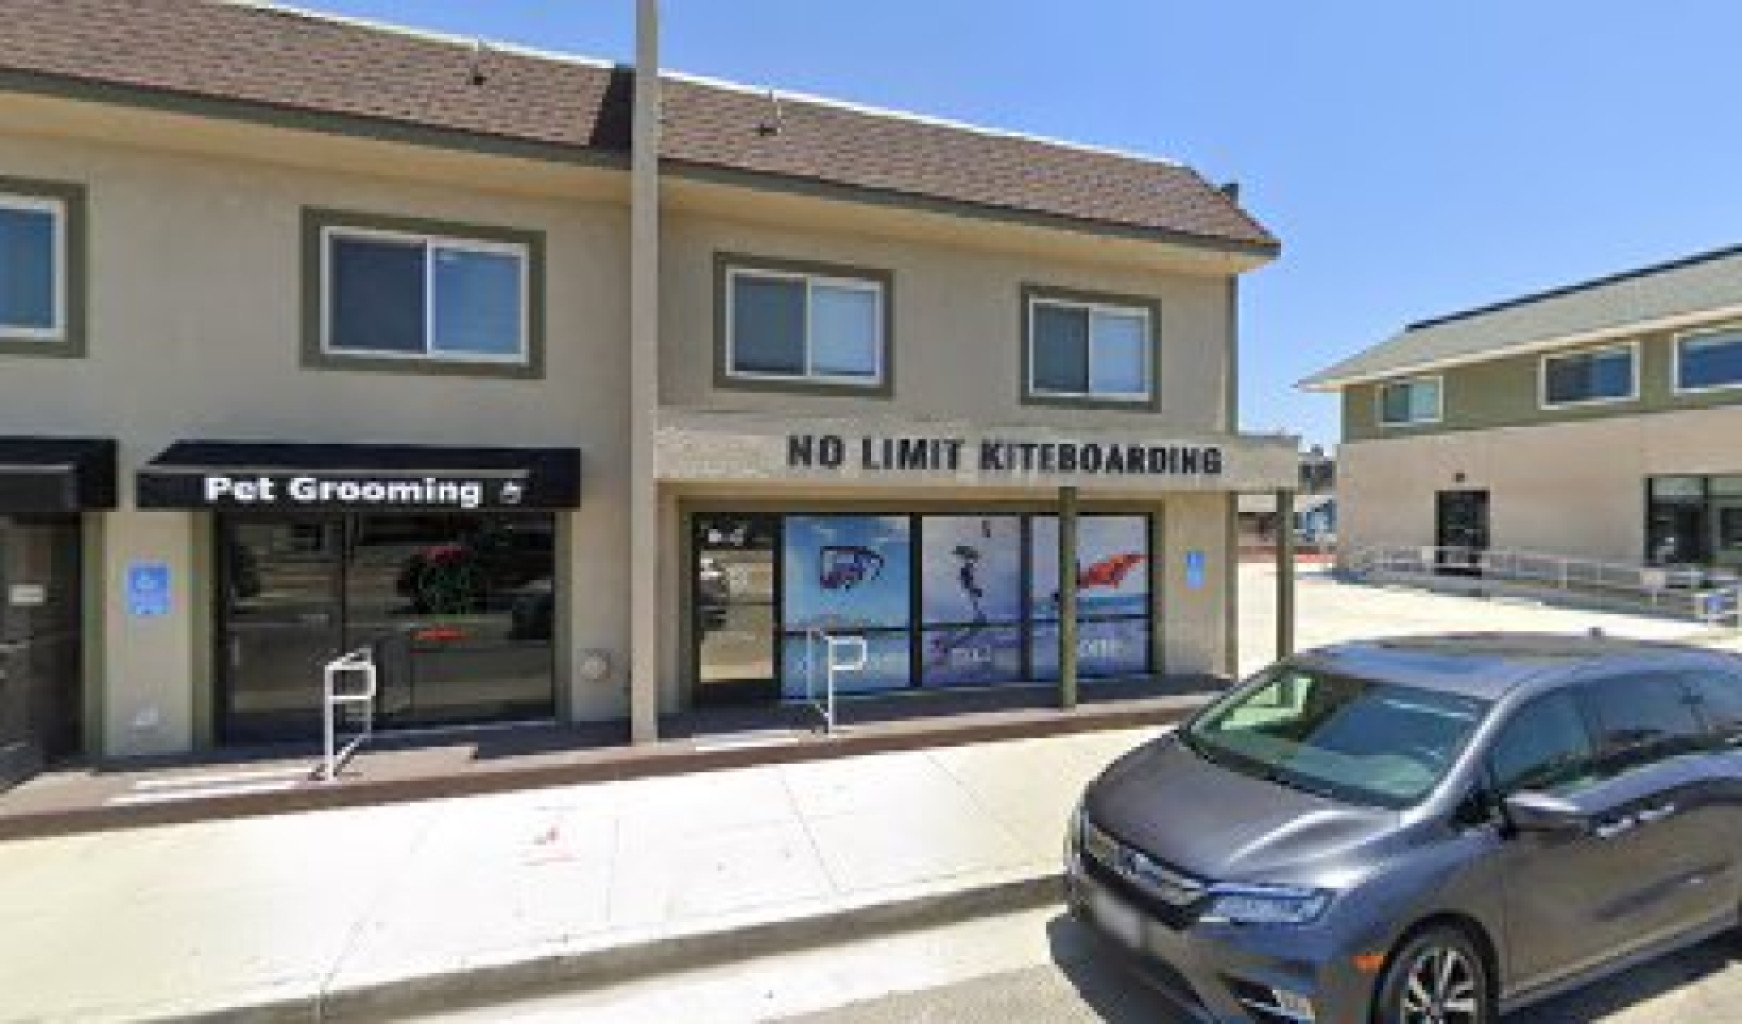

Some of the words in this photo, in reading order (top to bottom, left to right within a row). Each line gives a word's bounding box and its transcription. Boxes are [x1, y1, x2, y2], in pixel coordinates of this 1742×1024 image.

[787, 434, 845, 469] NO
[861, 438, 965, 470] LIMIT
[979, 441, 1222, 474] KITEBOARDING
[204, 476, 275, 501] Pet
[290, 476, 482, 508] Grooming
